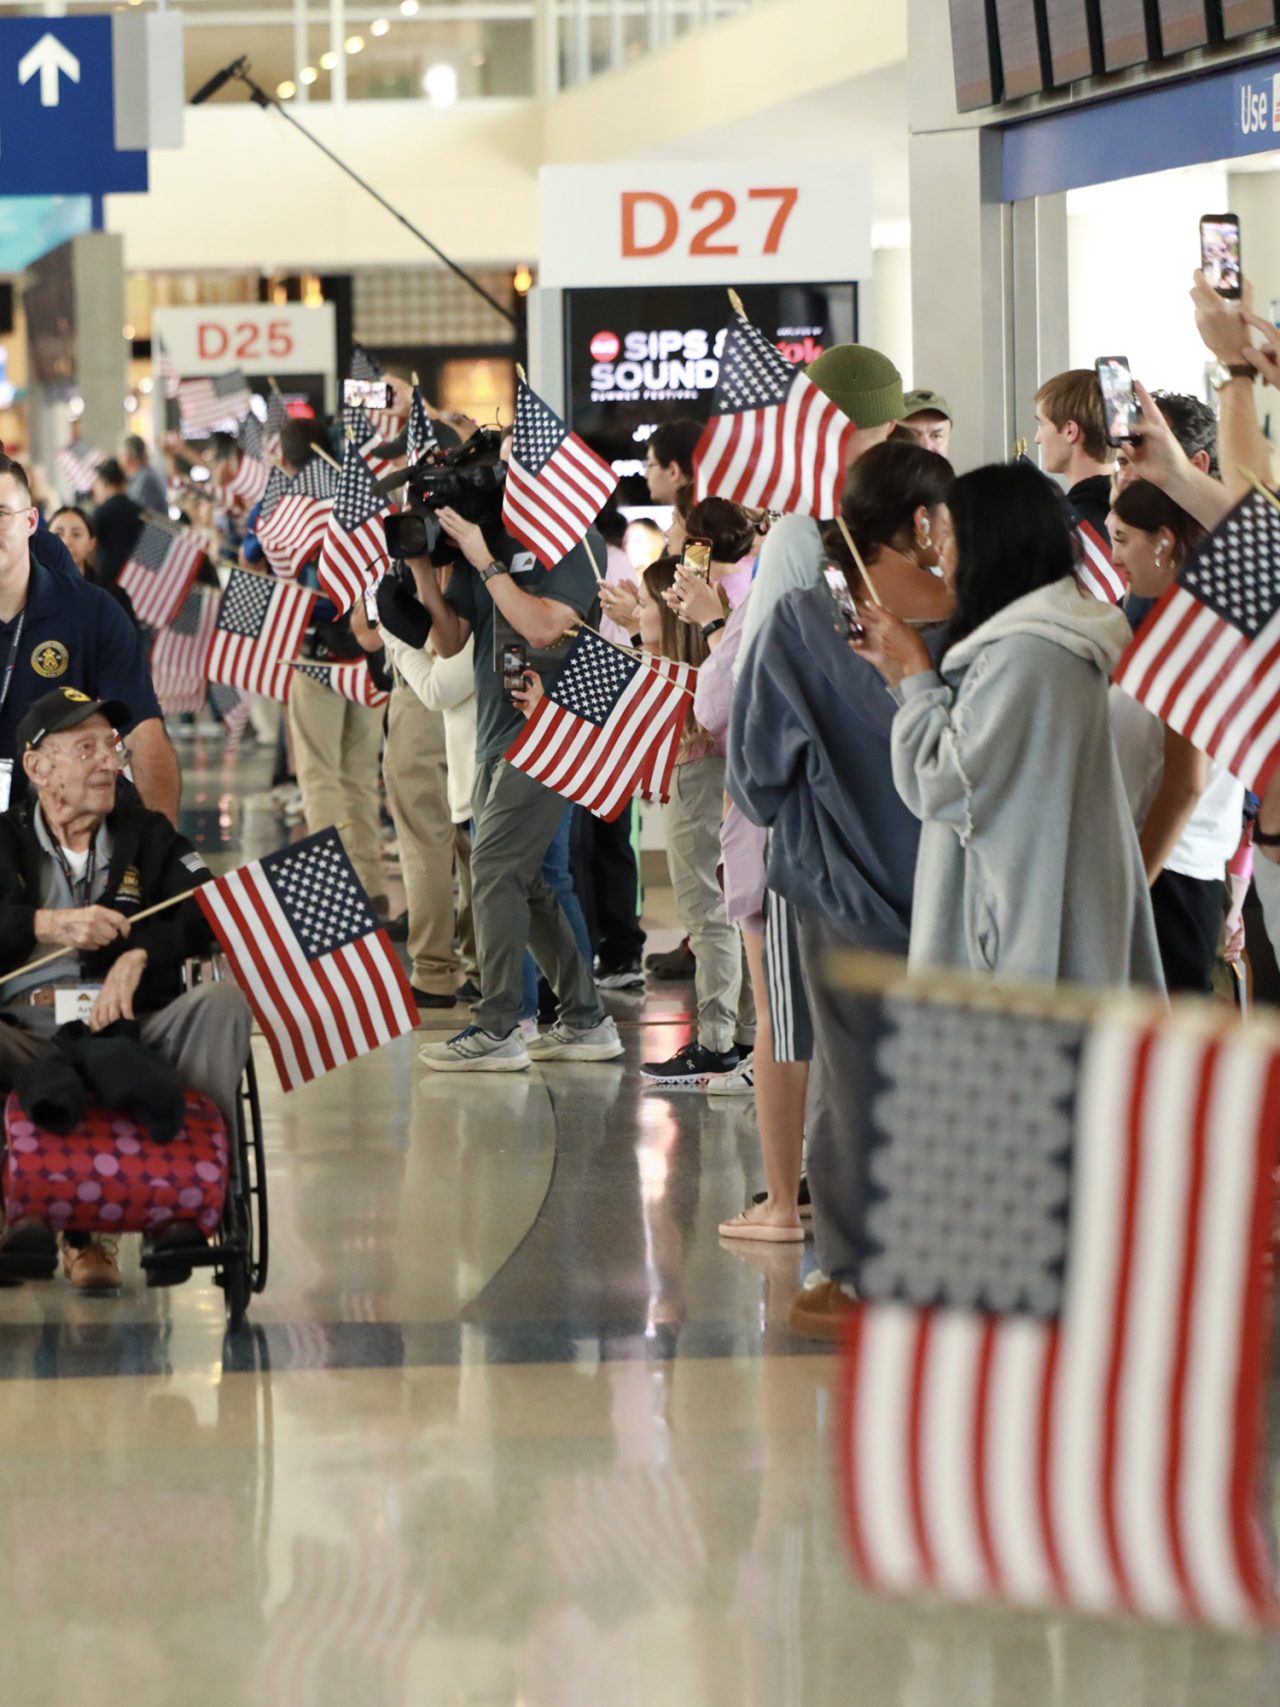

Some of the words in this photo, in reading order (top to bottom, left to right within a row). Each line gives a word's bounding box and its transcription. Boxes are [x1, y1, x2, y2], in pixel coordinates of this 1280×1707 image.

[1240, 84, 1268, 135] Use
[620, 187, 799, 258] D27
[197, 320, 294, 360] D25
[623, 328, 709, 361] SIPS
